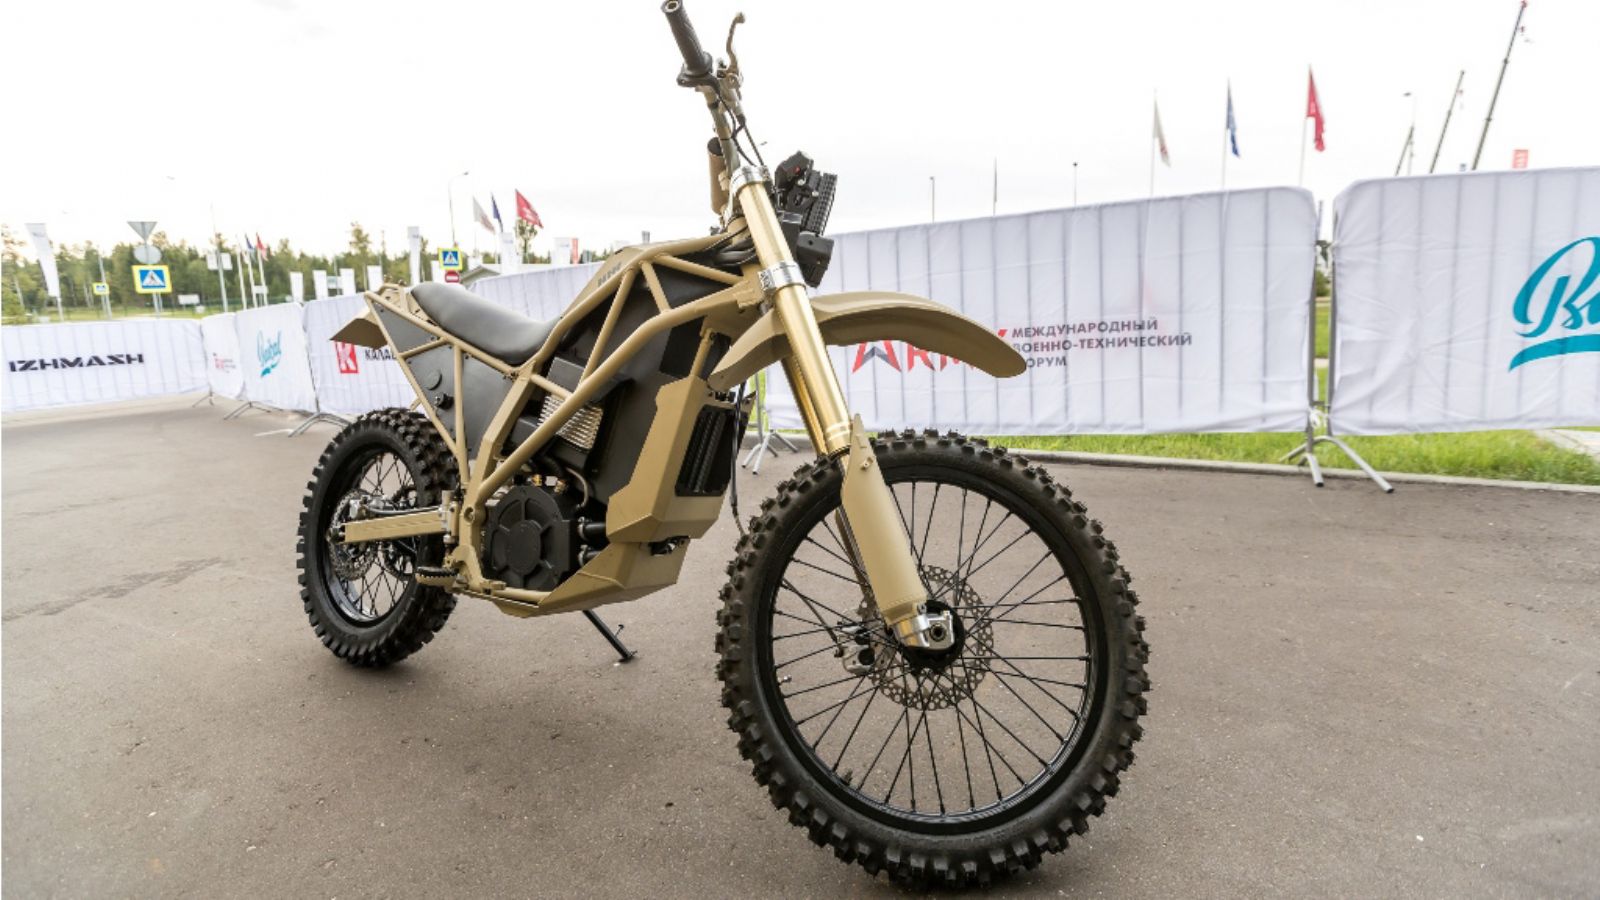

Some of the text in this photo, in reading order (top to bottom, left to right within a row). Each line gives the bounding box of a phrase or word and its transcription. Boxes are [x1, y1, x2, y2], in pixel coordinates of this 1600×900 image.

[1012, 317, 1158, 338] МЕЖДУНАРОДНЫЙ
[9, 353, 144, 372] IZHMASH
[1025, 356, 1067, 368] ОРУМ
